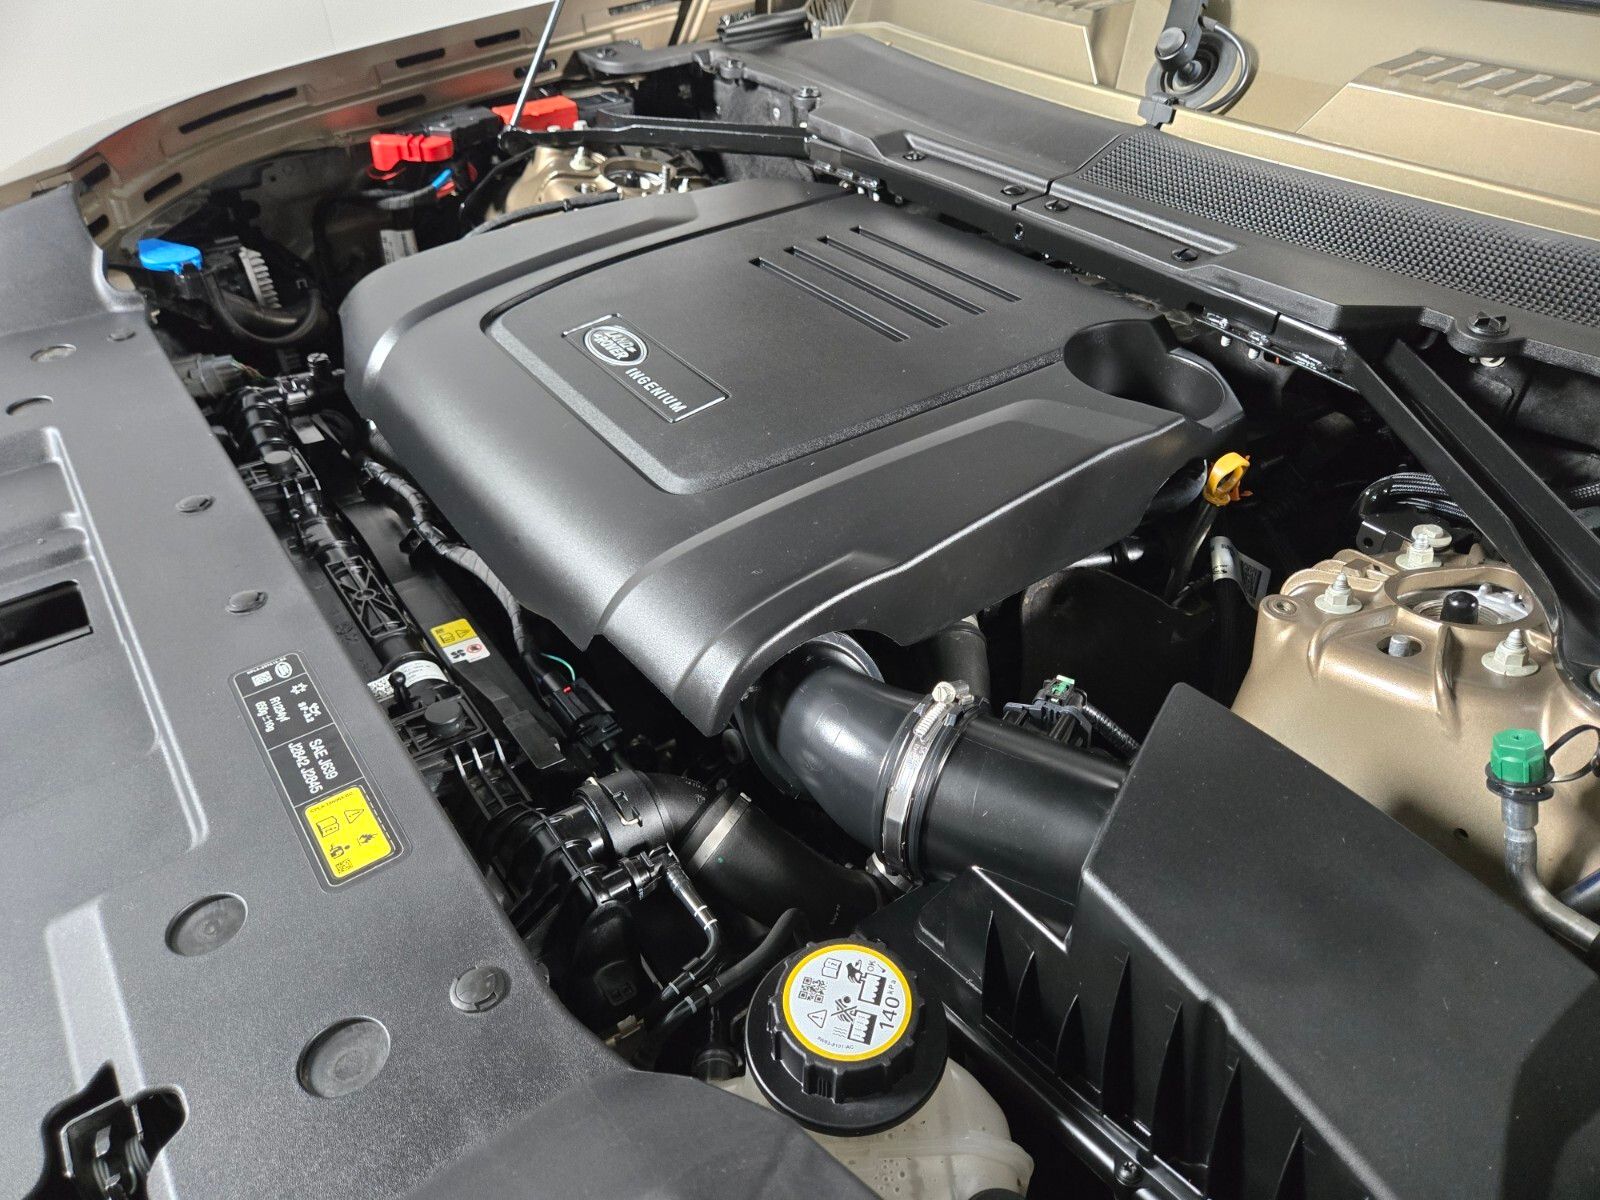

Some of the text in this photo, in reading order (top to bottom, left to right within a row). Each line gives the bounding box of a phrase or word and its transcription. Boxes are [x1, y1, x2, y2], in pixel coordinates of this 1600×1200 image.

[595, 334, 629, 359] ROVER
[602, 331, 637, 353] LAND
[625, 367, 688, 413] INGENIUM
[309, 738, 329, 760] SAE
[287, 742, 324, 794] J2842 J2845
[318, 758, 339, 780] J639
[866, 960, 877, 972] OK
[879, 996, 900, 1030] 140
